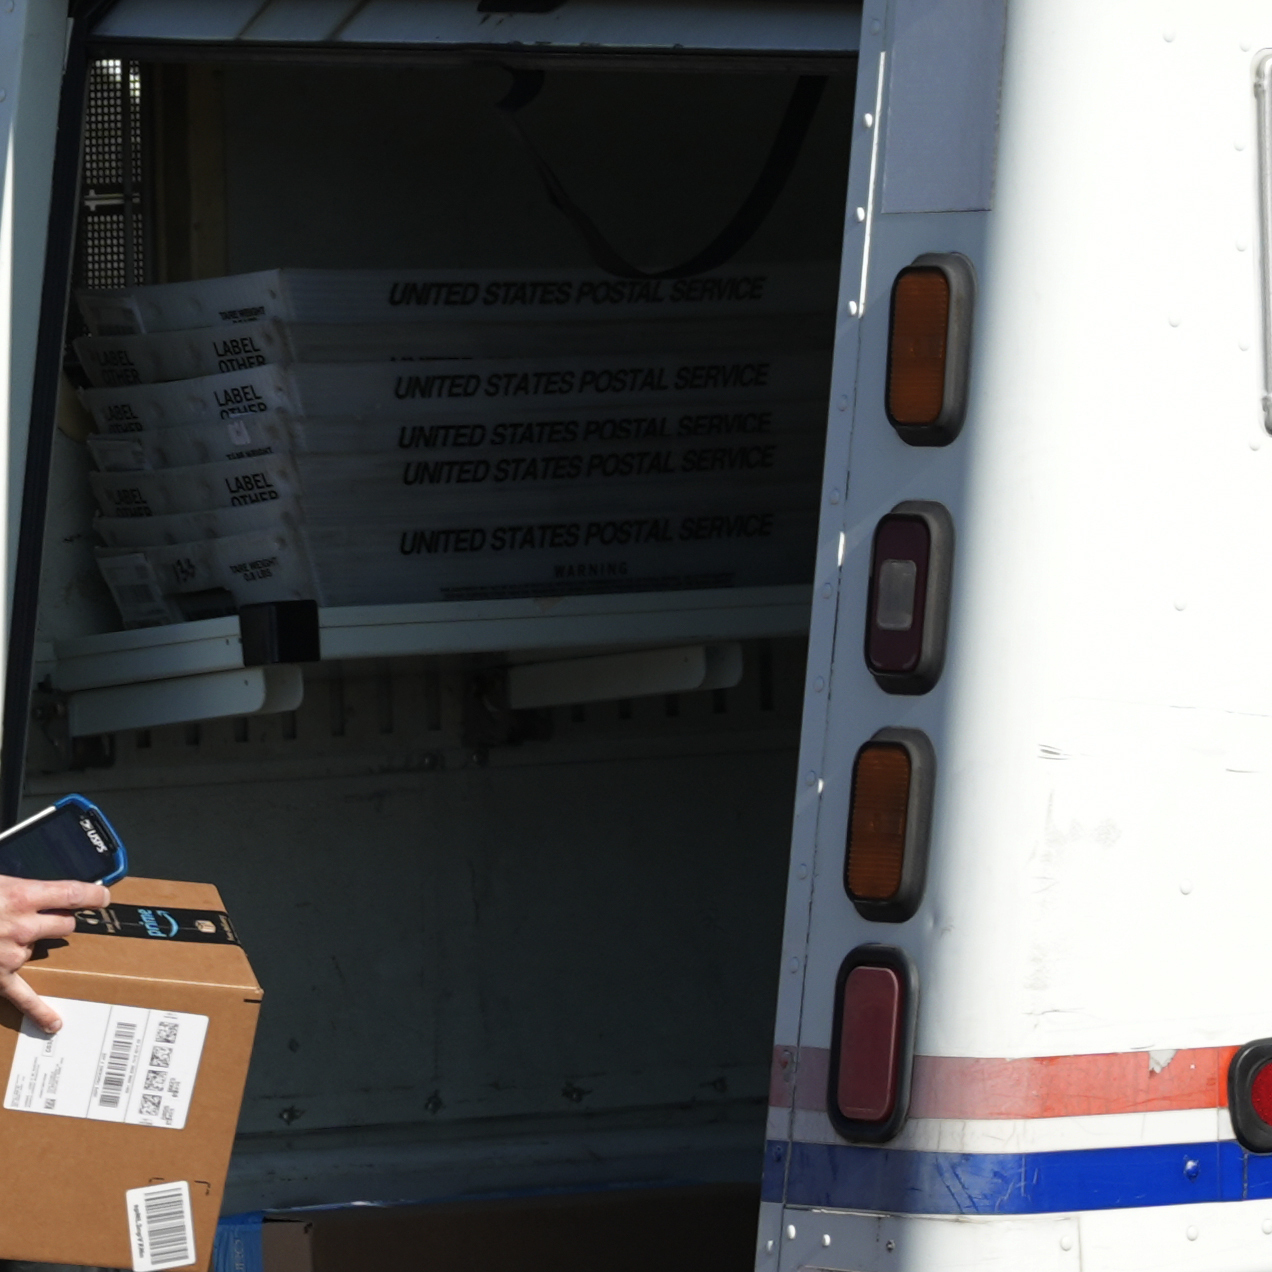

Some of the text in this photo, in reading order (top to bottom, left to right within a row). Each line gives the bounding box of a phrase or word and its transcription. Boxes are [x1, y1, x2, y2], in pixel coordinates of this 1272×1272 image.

[388, 276, 767, 307] UNITED STATES POSTAL SERVICE
[96, 350, 135, 367] LABEL
[213, 337, 261, 357] LABEL
[218, 355, 266, 373] OTHER
[394, 363, 770, 400] UNITED STATES POSTAL SERVICE
[213, 385, 263, 406] LABEL
[398, 412, 773, 449] UNITED STATES POSTAL SERVICE
[403, 445, 777, 486] UNITED STATES POSTAL SERVICE
[225, 472, 274, 493] LABEL
[231, 490, 279, 507] OTHER
[399, 513, 775, 556] UNITED STATES POSTAL SERVICE
[553, 562, 630, 580] WARNING
[86, 828, 109, 854] USPS
[147, 908, 166, 937] prime
